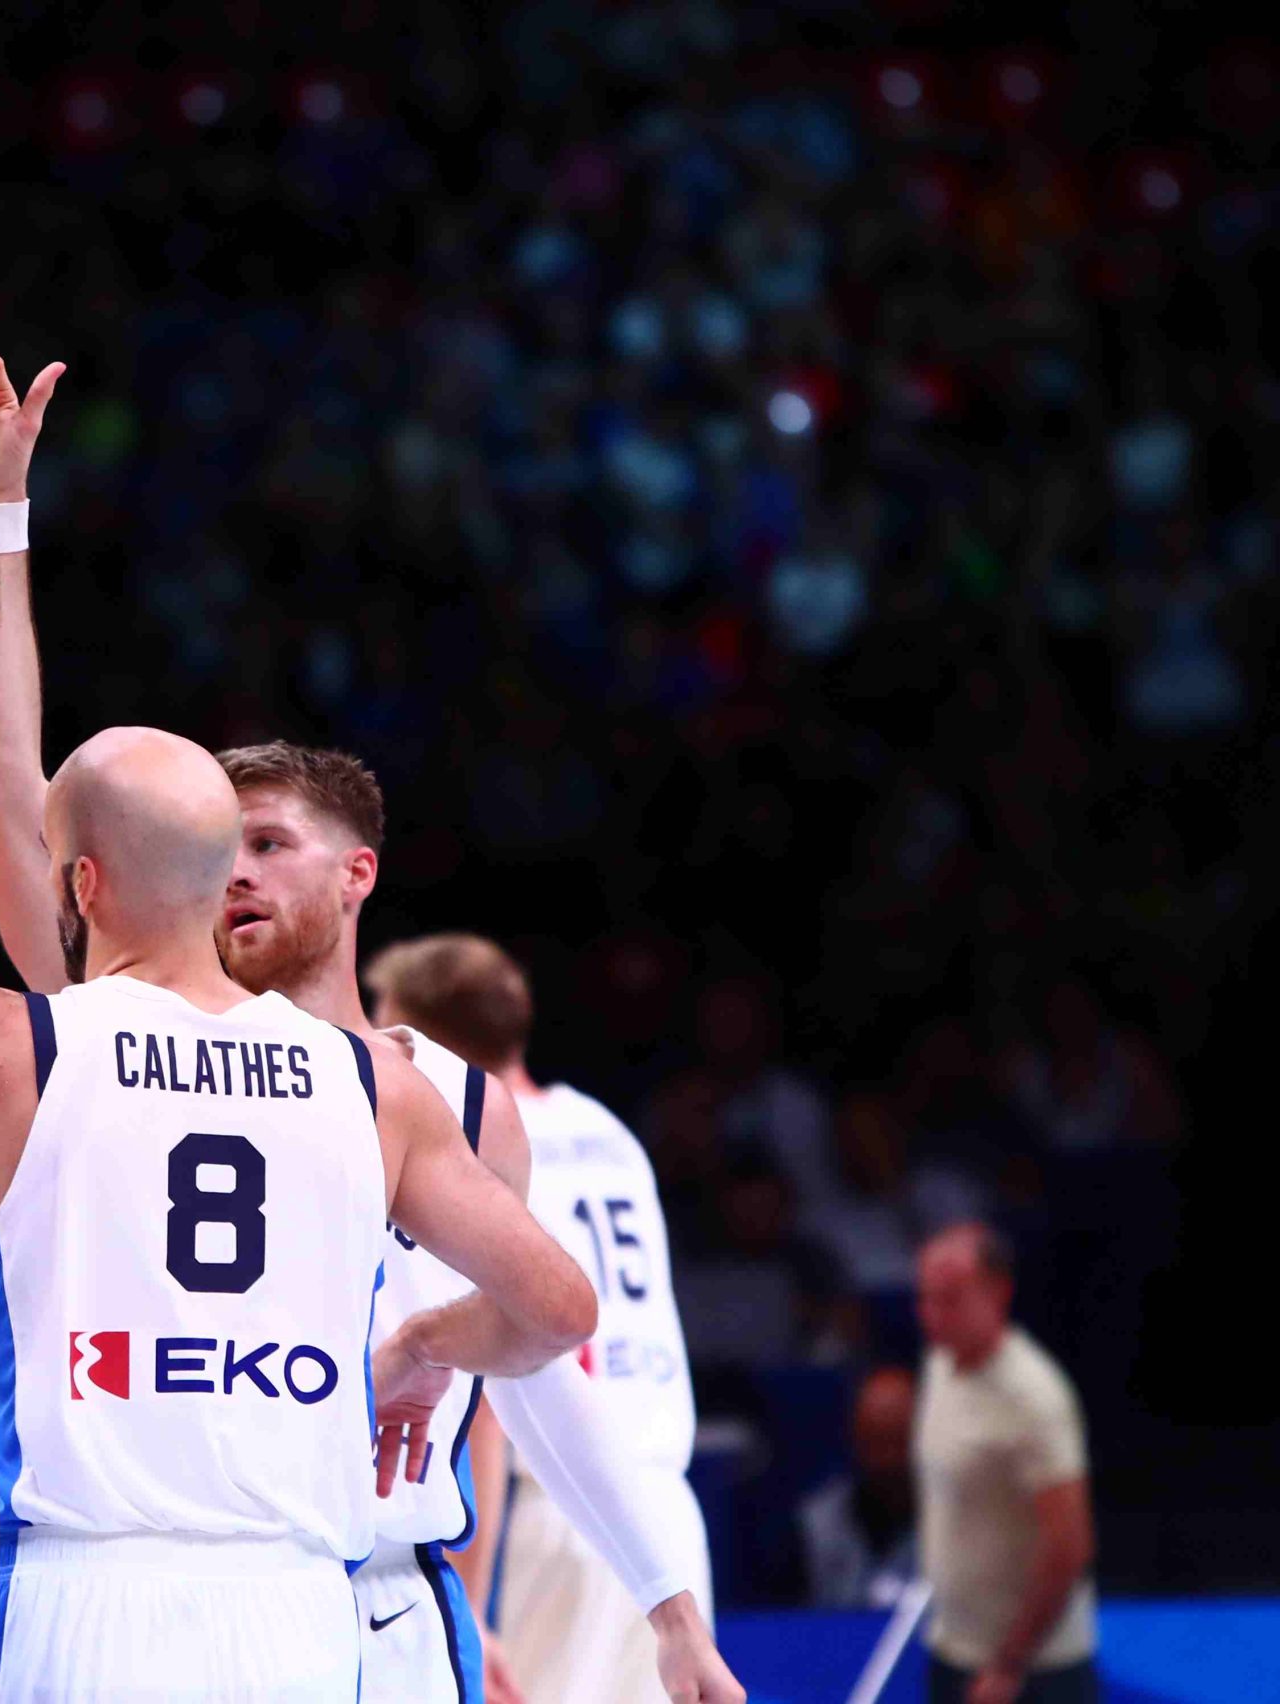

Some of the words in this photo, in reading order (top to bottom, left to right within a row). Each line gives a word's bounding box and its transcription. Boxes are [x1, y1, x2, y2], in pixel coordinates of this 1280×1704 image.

[115, 1031, 313, 1099] CALATHES
[166, 1133, 266, 1294] 8
[573, 1198, 647, 1301] 15
[155, 1338, 338, 1405] EKO
